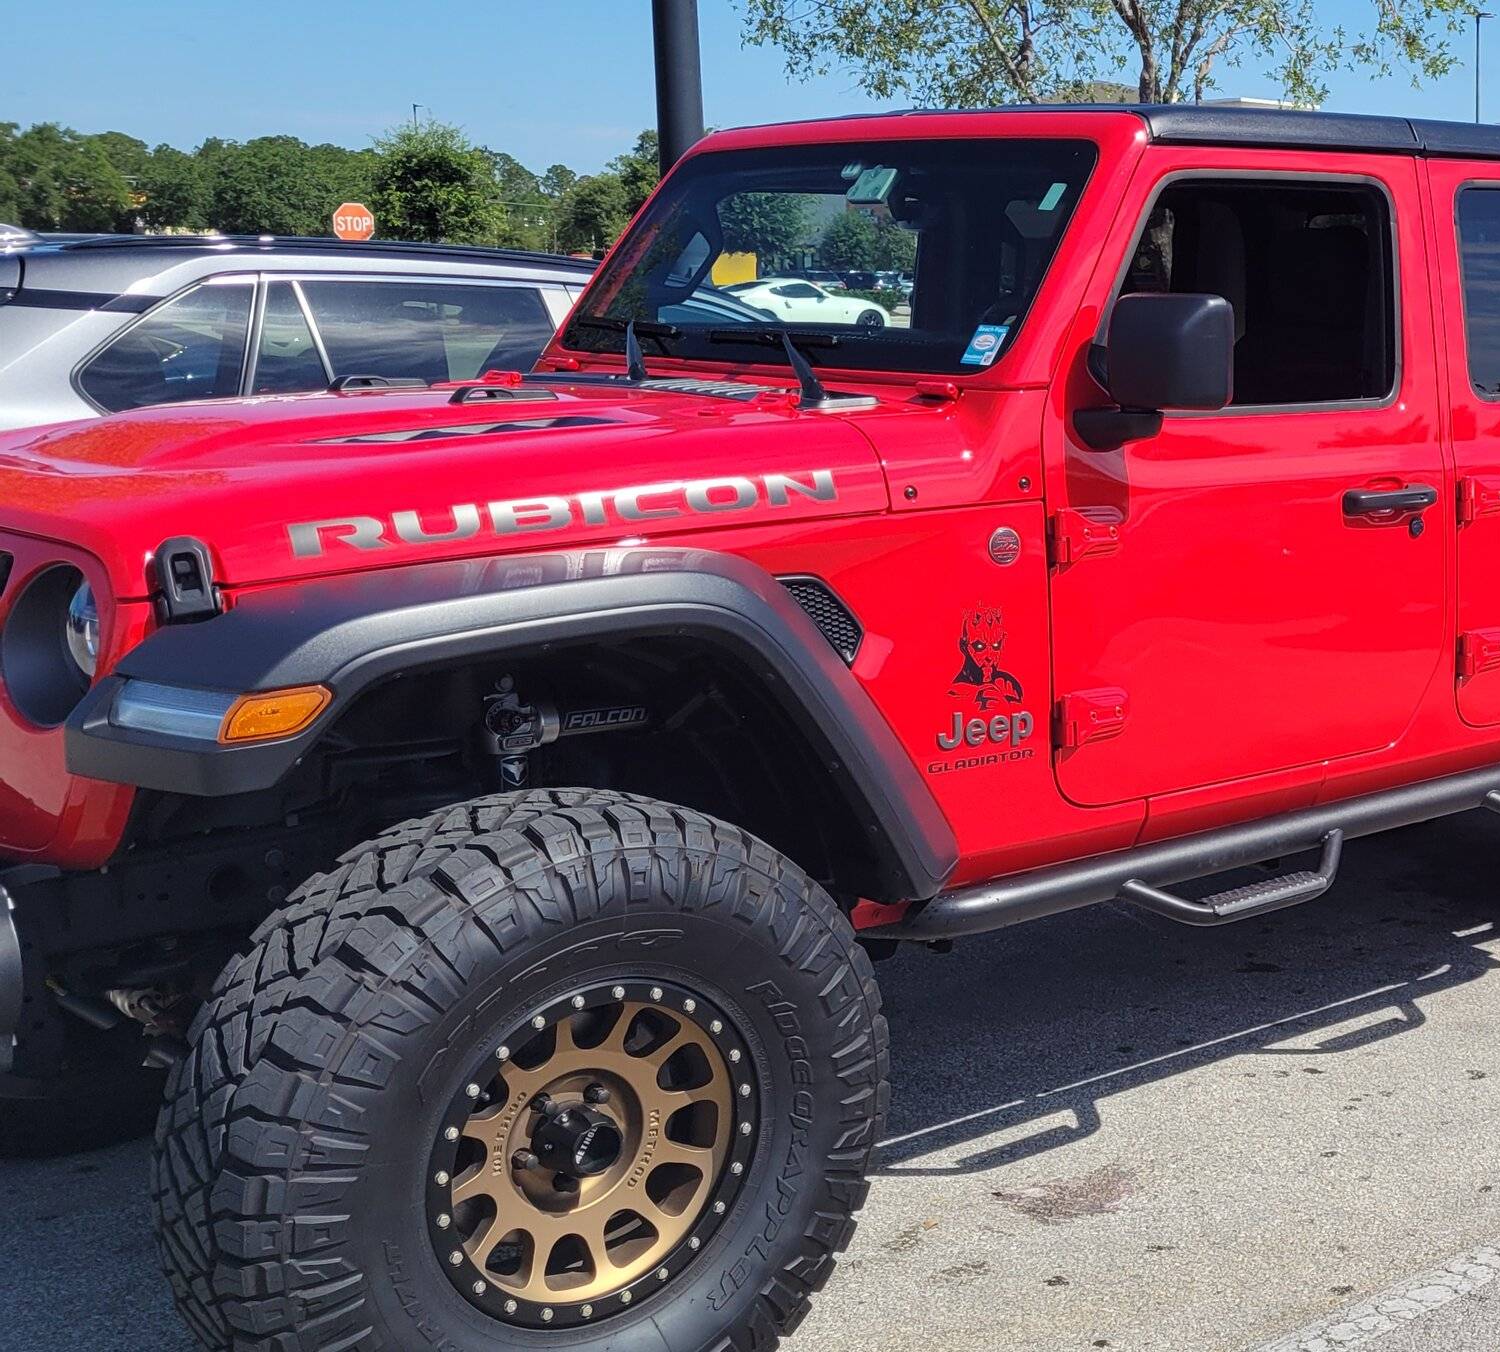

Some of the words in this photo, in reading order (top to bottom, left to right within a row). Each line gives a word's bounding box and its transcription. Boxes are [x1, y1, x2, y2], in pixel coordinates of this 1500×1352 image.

[337, 216, 371, 232] STOP
[286, 469, 840, 559] RUBICON
[568, 706, 647, 728] FALCON
[935, 710, 1034, 751] Jeep
[927, 748, 1035, 774] GLADIATOR
[491, 1091, 528, 1177] METHOD
[627, 1108, 660, 1188] METHOD
